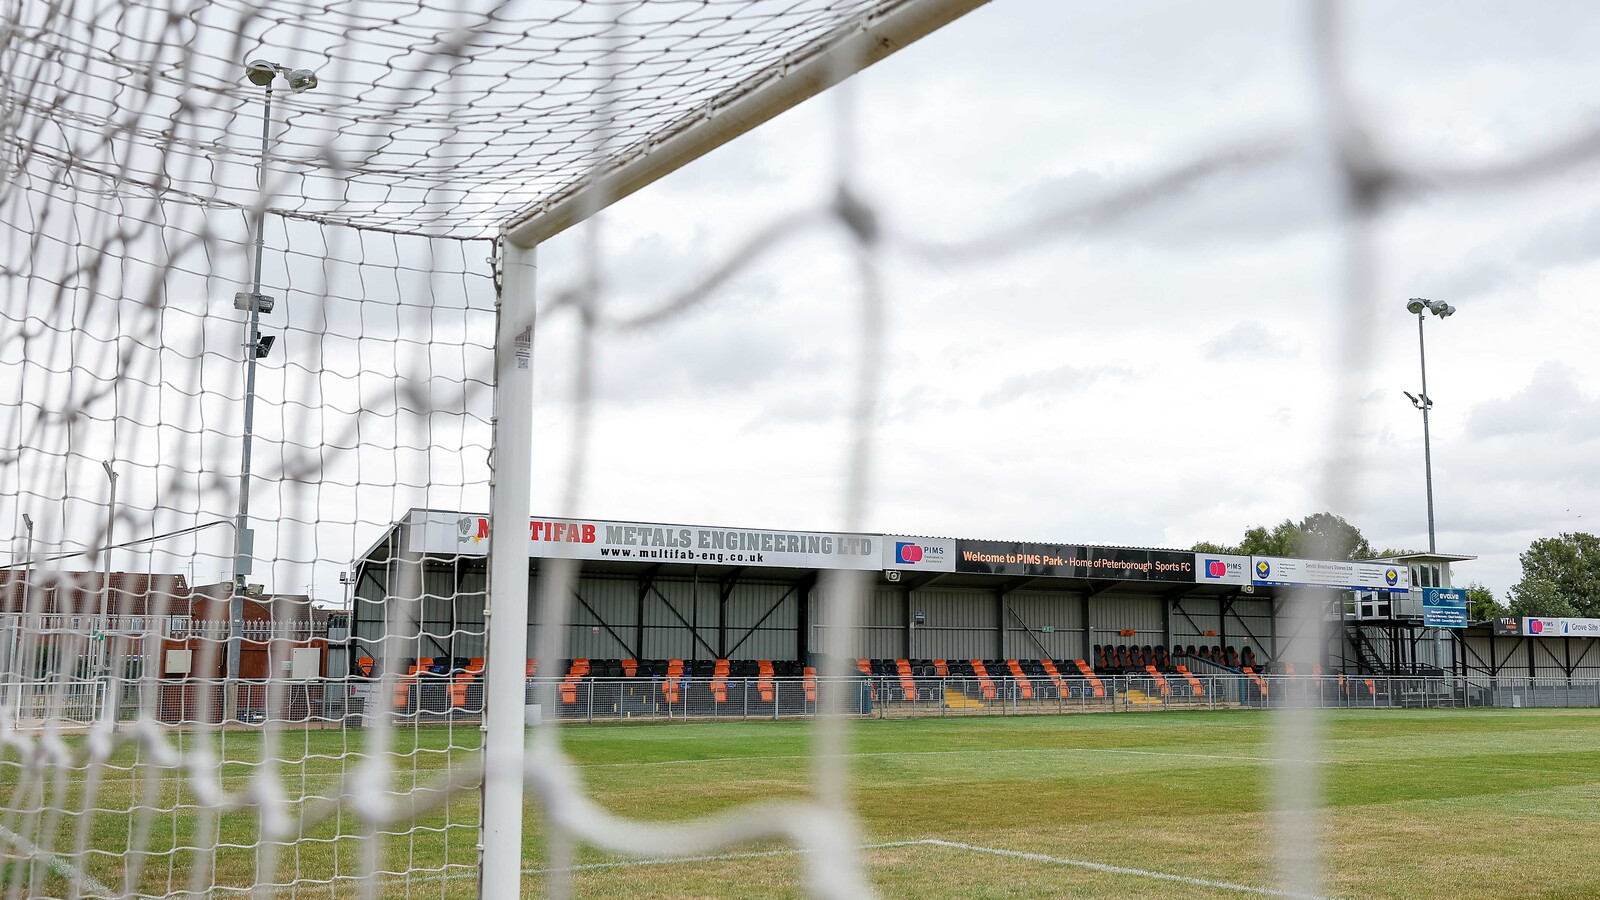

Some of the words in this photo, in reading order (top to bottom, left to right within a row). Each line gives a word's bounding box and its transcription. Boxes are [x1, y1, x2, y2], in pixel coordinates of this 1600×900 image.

[478, 518, 596, 544] MTIFAB
[605, 525, 692, 549] METALS
[697, 530, 833, 555] ENGINEERING
[837, 537, 872, 556] LTD
[600, 548, 763, 562] www.multifab-eng.co.uk
[924, 546, 944, 554] PIMS
[963, 551, 1004, 563] Welcome
[1006, 553, 1016, 563] to
[1017, 554, 1041, 565] PIMS
[1043, 556, 1063, 566] Park
[1069, 557, 1092, 568] Home
[1093, 559, 1102, 568] of
[1102, 559, 1152, 573] Peterborough
[1155, 561, 1180, 572] Sports
[1181, 562, 1191, 572] FC
[1500, 617, 1517, 625] VITAL
[1571, 623, 1587, 631] Grove
[1587, 623, 1599, 631] Site
